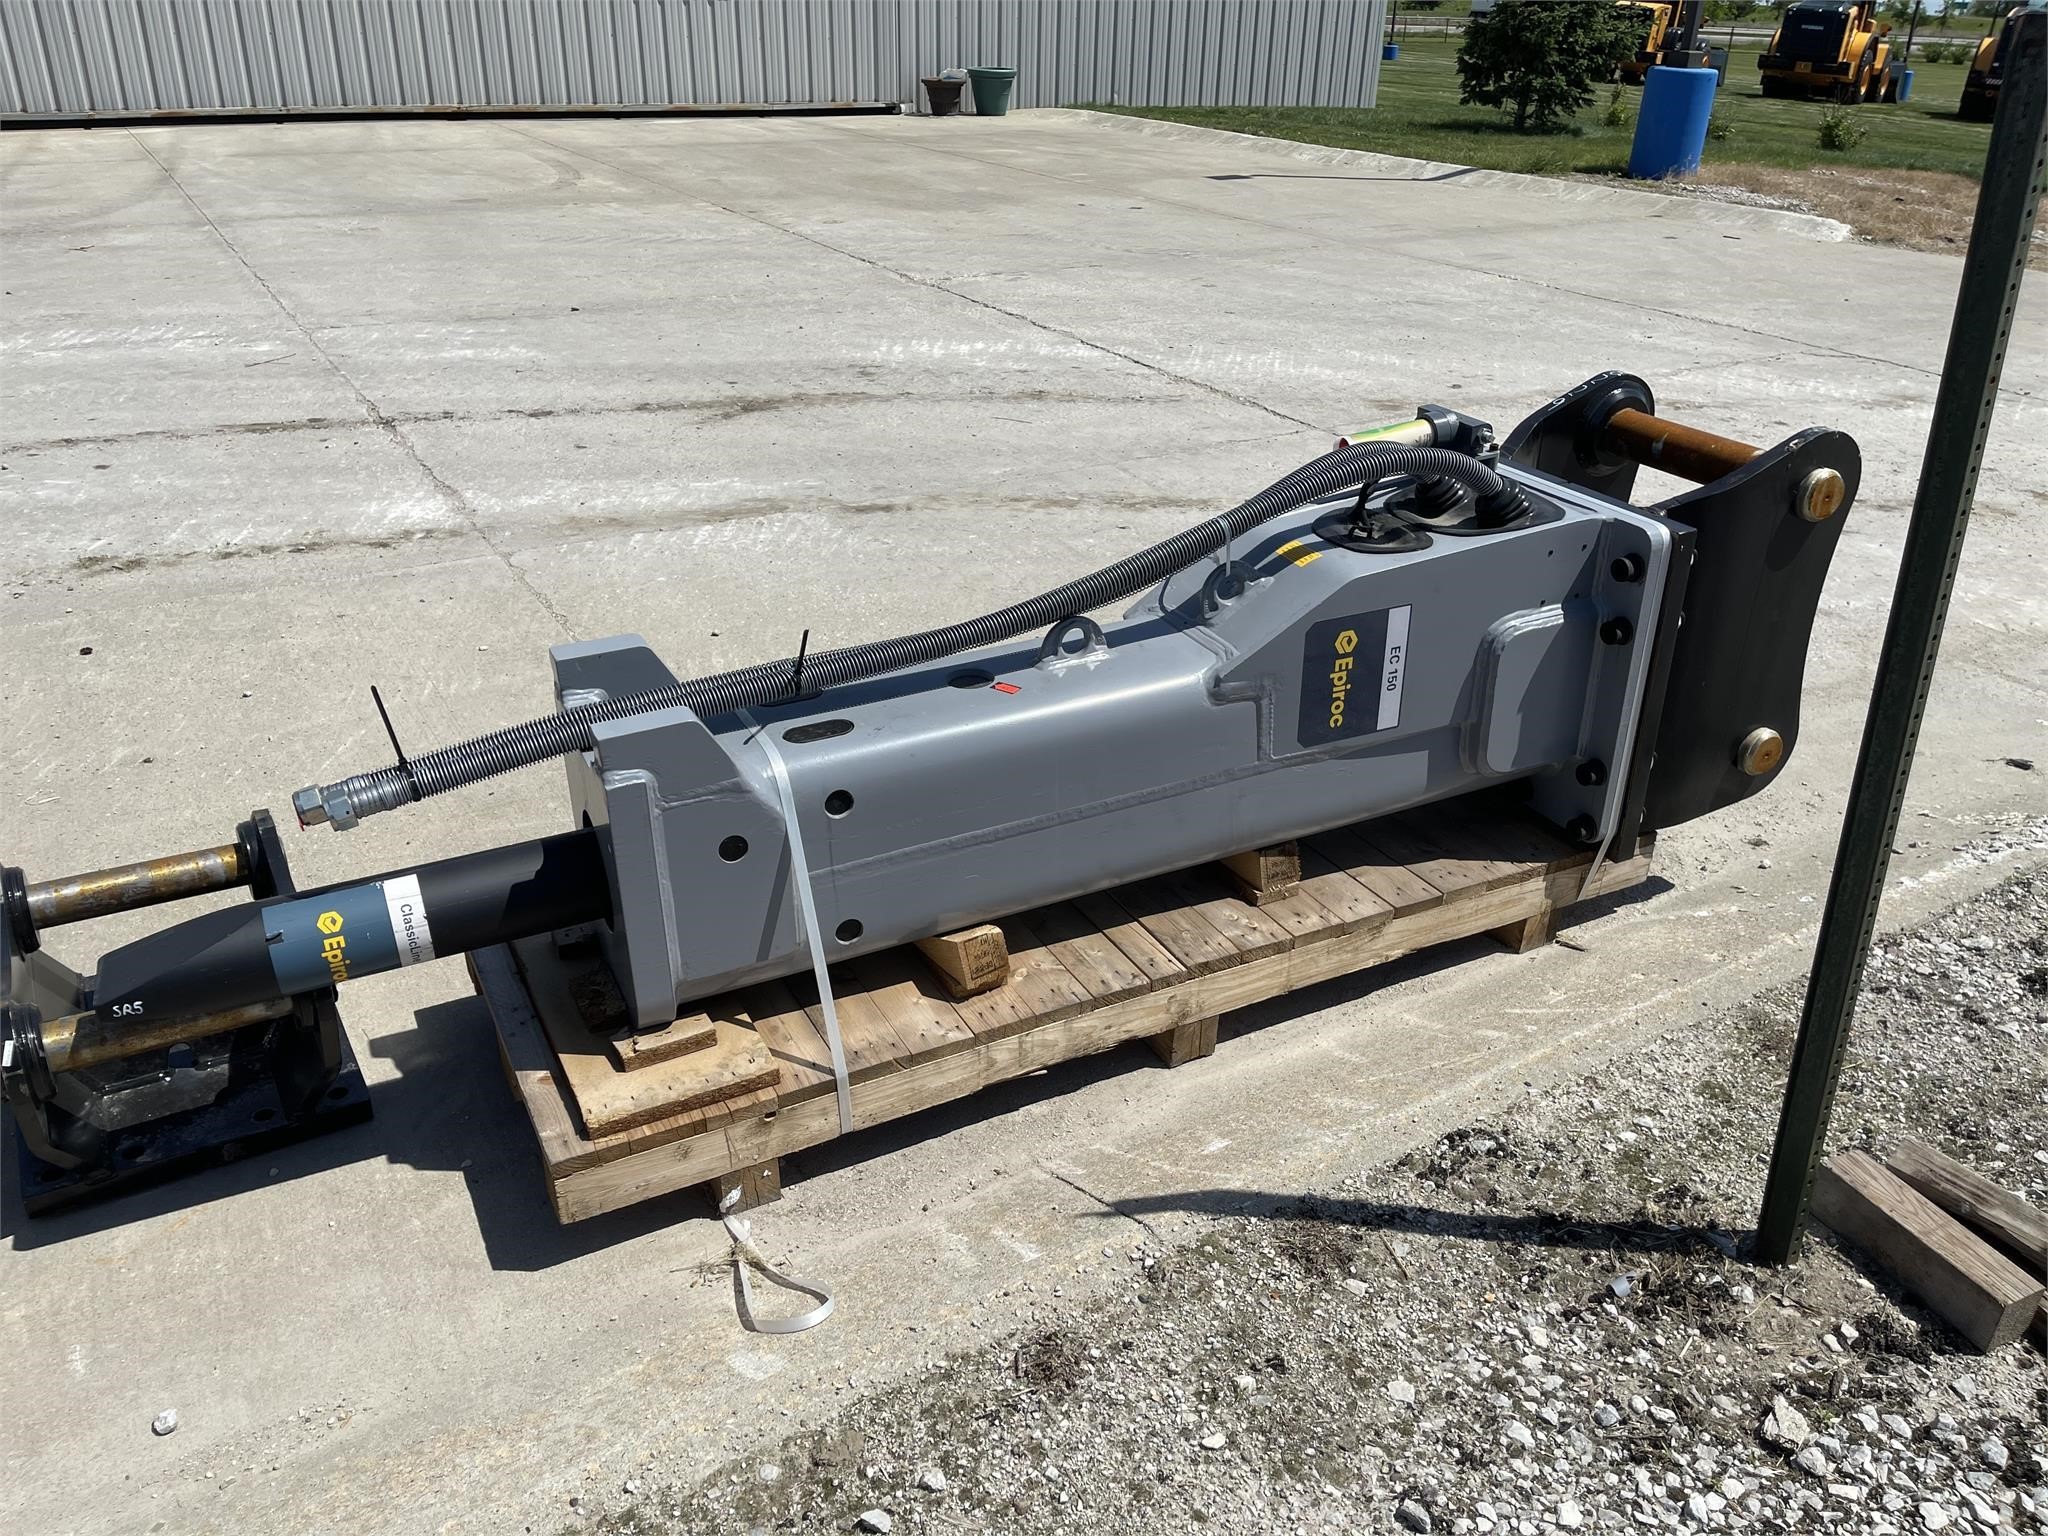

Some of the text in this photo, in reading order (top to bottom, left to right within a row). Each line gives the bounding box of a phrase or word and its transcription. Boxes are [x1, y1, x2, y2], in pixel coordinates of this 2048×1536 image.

[1386, 645, 1401, 692] EC 150
[1329, 656, 1354, 729] Epiroc
[321, 935, 351, 982] Epiro
[112, 1000, 144, 1018] SR5
